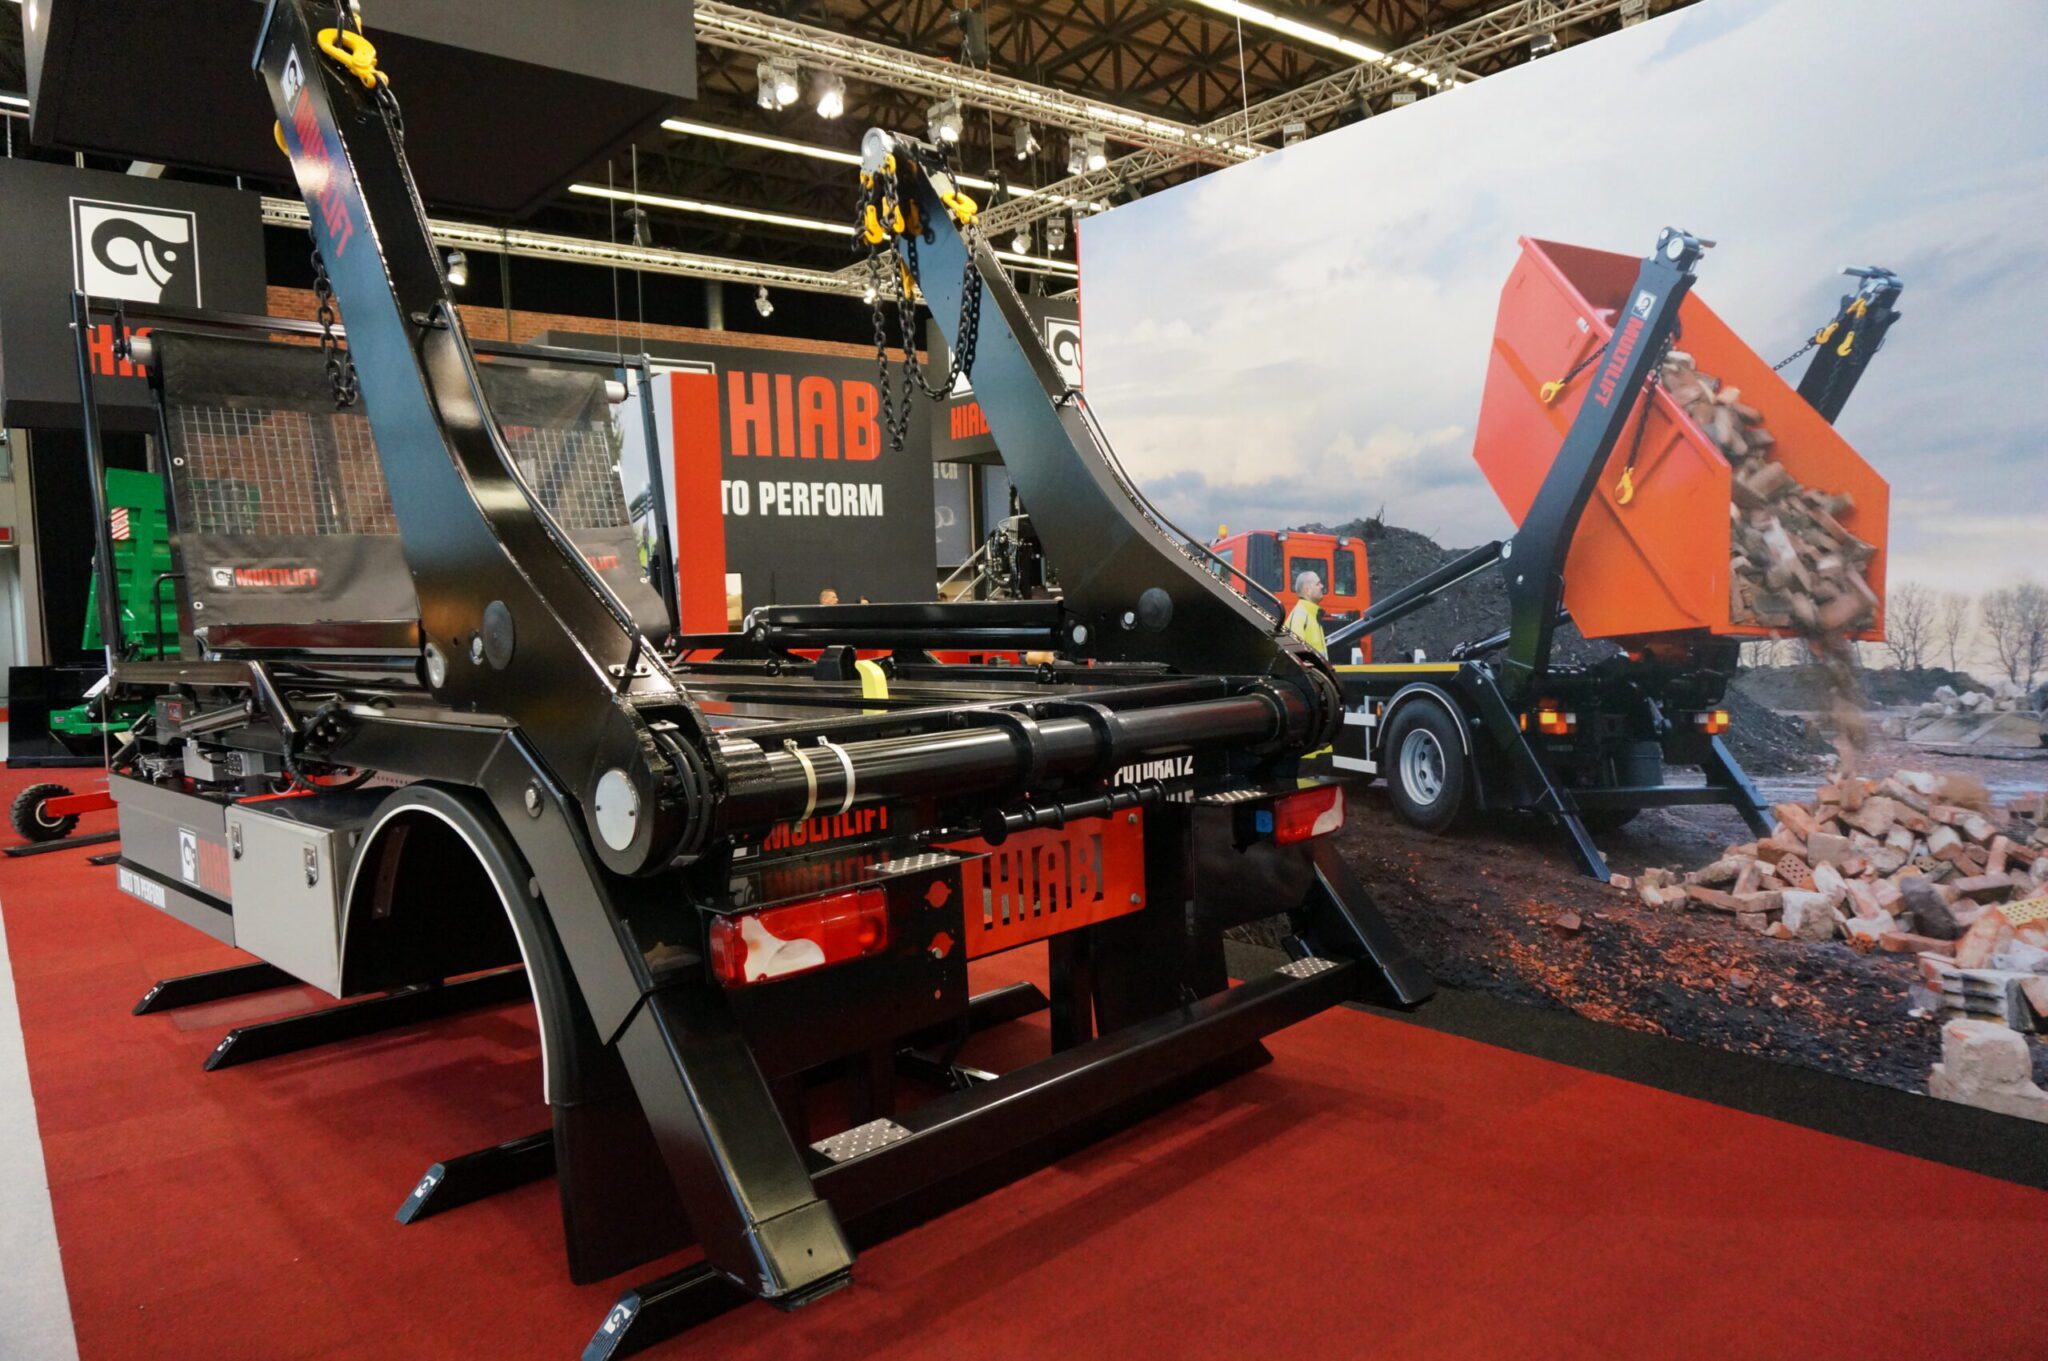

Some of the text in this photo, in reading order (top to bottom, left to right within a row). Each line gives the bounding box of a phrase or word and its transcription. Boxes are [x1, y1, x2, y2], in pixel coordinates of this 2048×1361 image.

[291, 86, 354, 258] MULLIFT
[1594, 316, 1645, 408] MULTILIFT
[727, 370, 881, 461] HIAB
[721, 479, 884, 517] TO PERFORM
[235, 568, 318, 587] MULTILIFT
[983, 832, 1103, 930] HIAB
